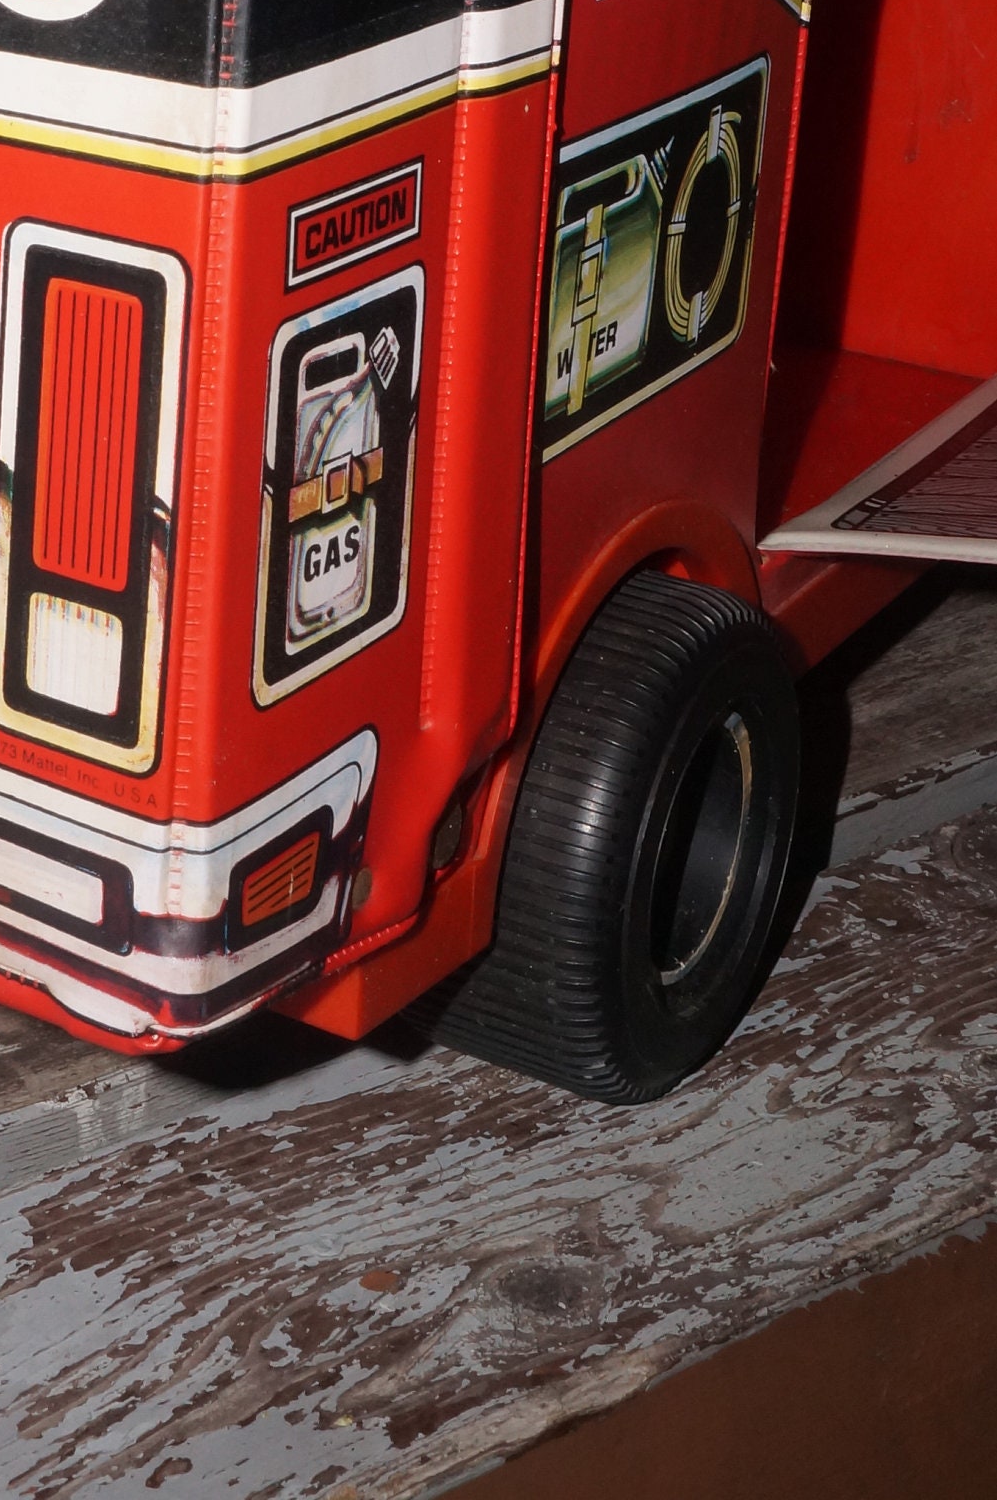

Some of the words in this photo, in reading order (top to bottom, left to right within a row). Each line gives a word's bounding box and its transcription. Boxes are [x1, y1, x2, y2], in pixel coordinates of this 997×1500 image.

[305, 188, 407, 260] CAUTION
[557, 320, 618, 380] WTER
[304, 525, 360, 583] GAS
